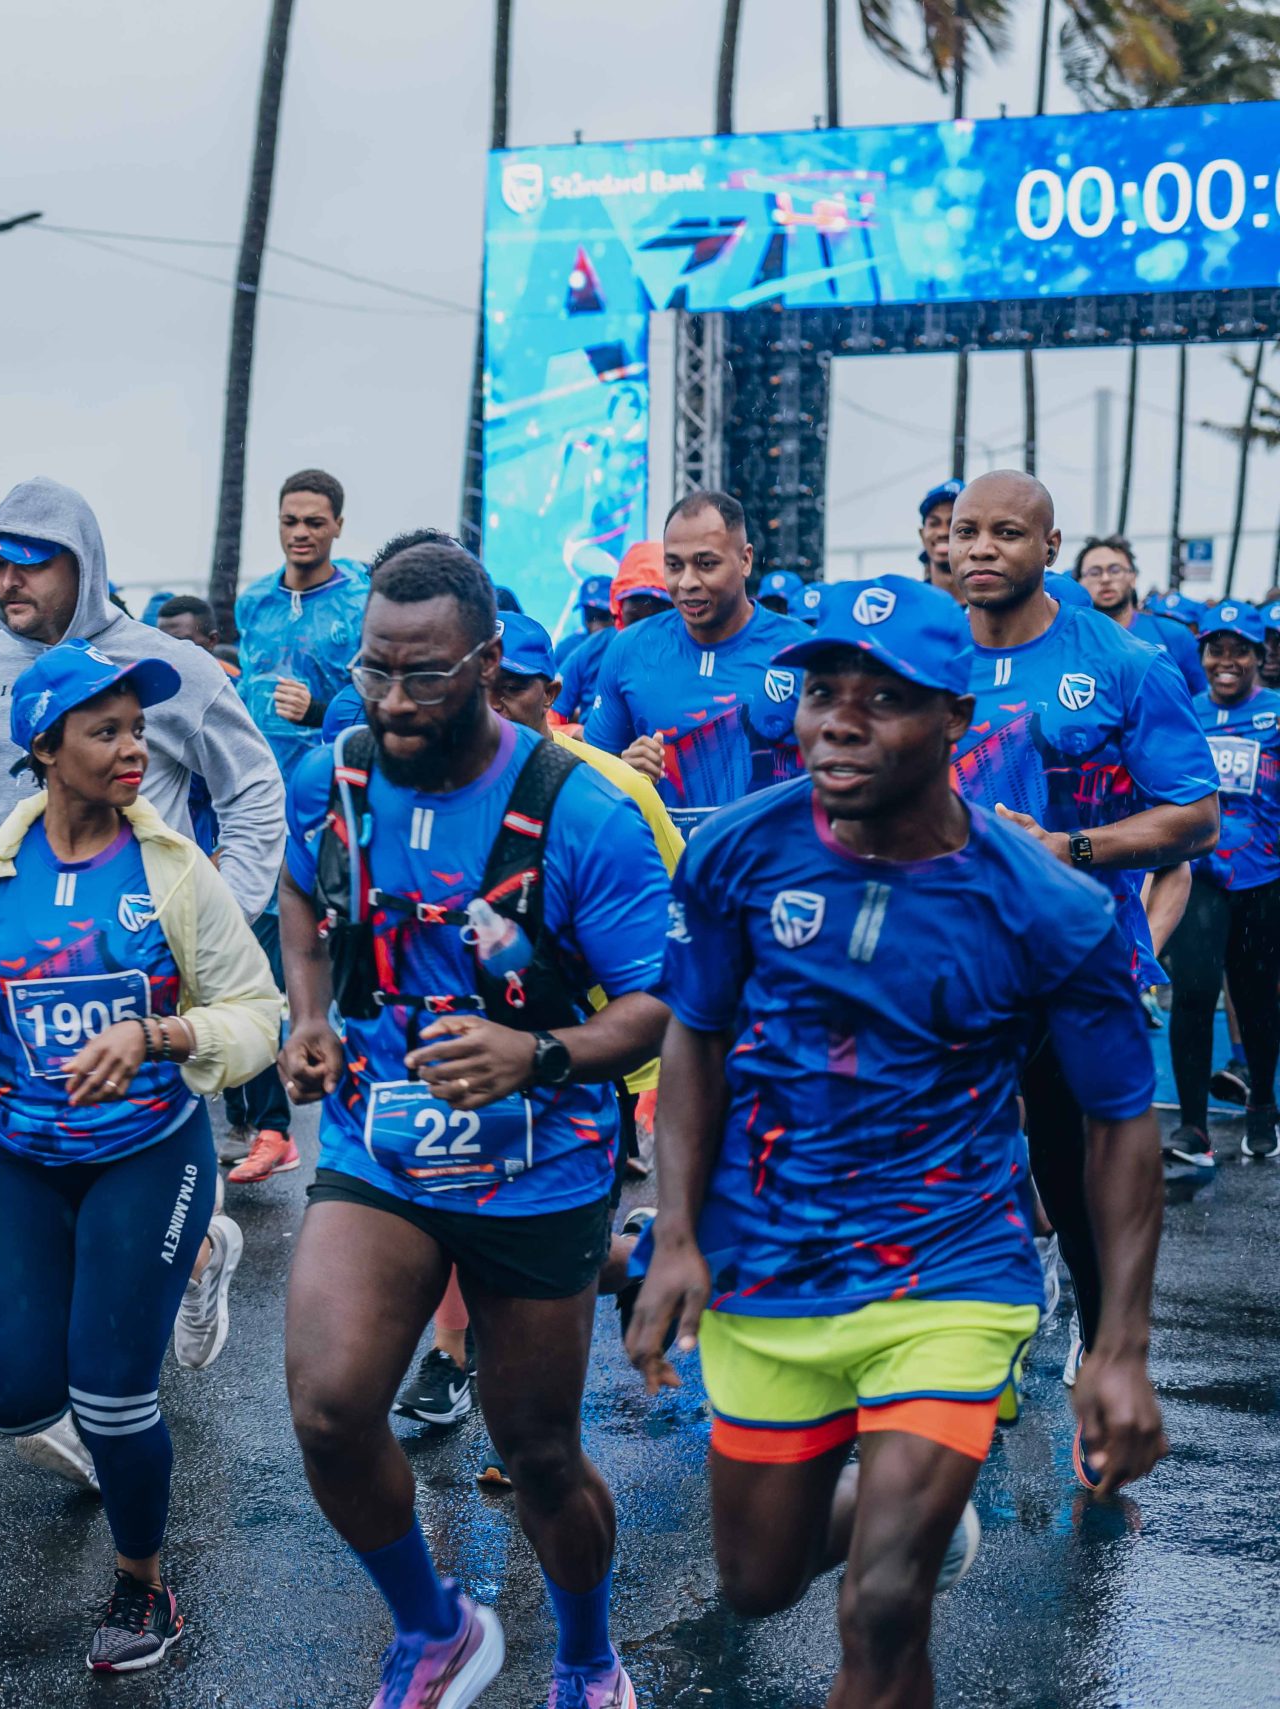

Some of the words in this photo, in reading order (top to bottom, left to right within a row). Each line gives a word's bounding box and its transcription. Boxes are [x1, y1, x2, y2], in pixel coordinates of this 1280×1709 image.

[650, 165, 706, 193] Bank
[1015, 158, 1280, 241] 00:00:
[414, 1107, 481, 1157] 22
